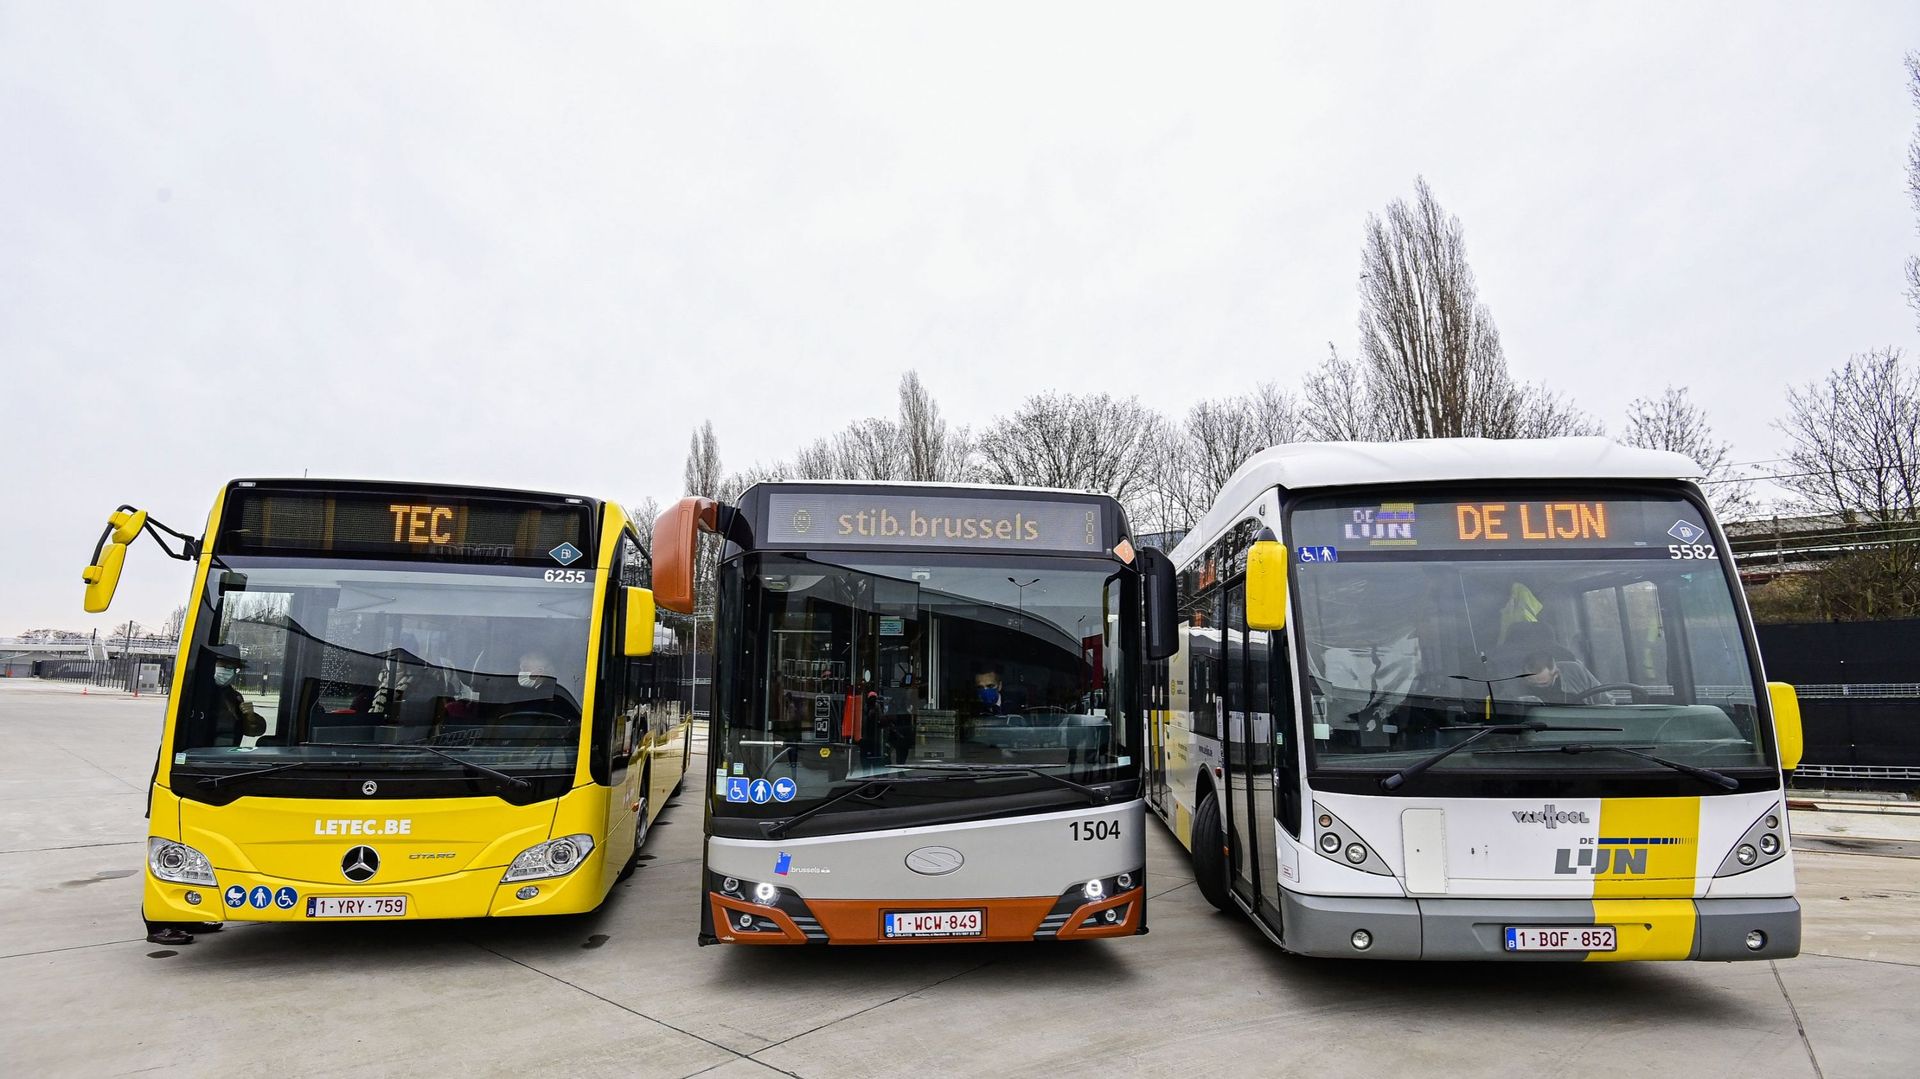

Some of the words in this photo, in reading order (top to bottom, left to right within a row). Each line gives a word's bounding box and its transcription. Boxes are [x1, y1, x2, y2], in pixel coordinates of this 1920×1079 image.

[389, 505, 453, 544] TEC
[838, 508, 1040, 541] stib.brussels
[1456, 504, 1509, 540] DE
[1519, 503, 1607, 540] LIJN
[1668, 544, 1719, 560] 5582
[544, 569, 586, 584] 6255
[314, 819, 412, 835] LETEC.BE
[1069, 820, 1121, 841] 1504
[1579, 837, 1595, 845] DE
[1554, 848, 1648, 875] LIJN
[1508, 940, 1516, 948] B
